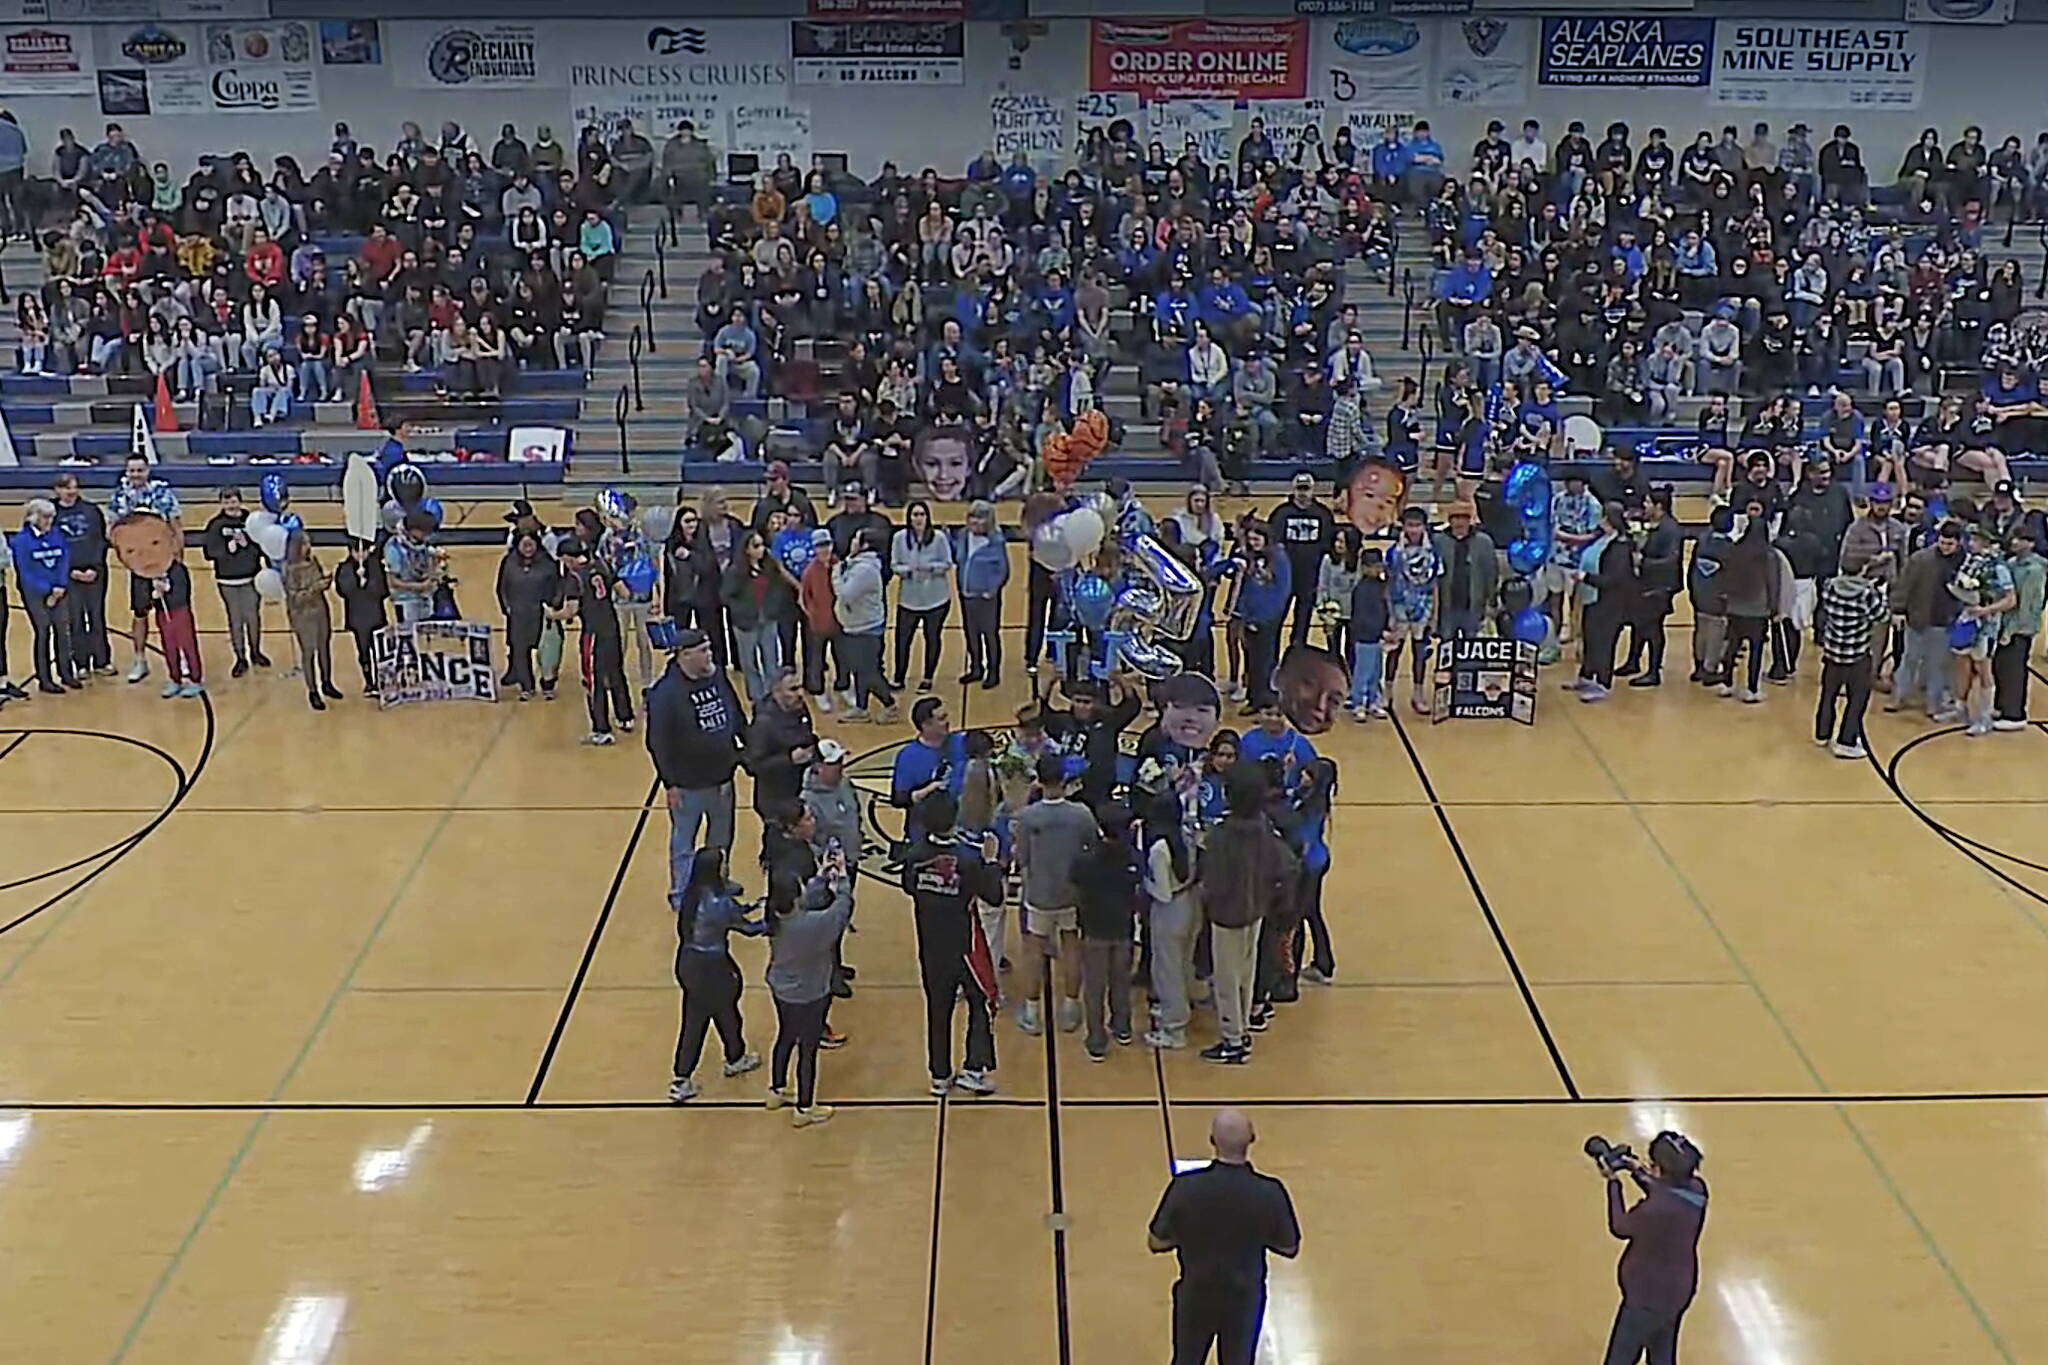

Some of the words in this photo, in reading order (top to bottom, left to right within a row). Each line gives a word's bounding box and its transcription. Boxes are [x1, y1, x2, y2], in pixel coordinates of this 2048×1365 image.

[1551, 20, 1663, 43] ALASKA
[1736, 27, 1909, 50] SOUTHEAST
[1110, 51, 1193, 71] ORDER
[1199, 51, 1288, 71] ONLINE
[1550, 44, 1704, 67] SEAPLANES
[1722, 50, 1794, 70] MINE
[1807, 52, 1916, 72] SUPPLY
[212, 69, 278, 101] Coppa
[572, 64, 681, 86] PRINCESS
[689, 64, 787, 86] CRUISES
[861, 70, 917, 80] FALCONS
[1110, 73, 1137, 84] AND
[1187, 73, 1226, 84] AFTER
[1226, 73, 1249, 84] THE
[1251, 73, 1287, 84] GAME
[1585, 74, 1598, 82] AT
[1600, 74, 1607, 82] A
[1647, 74, 1700, 83] STANDARD
[1077, 94, 1118, 117] #25
[997, 130, 1063, 155] ASHLYN
[1456, 641, 1513, 660] JACE
[376, 632, 492, 698] LANCE
[690, 685, 718, 704] STAY
[1456, 705, 1506, 717] FALCONS
